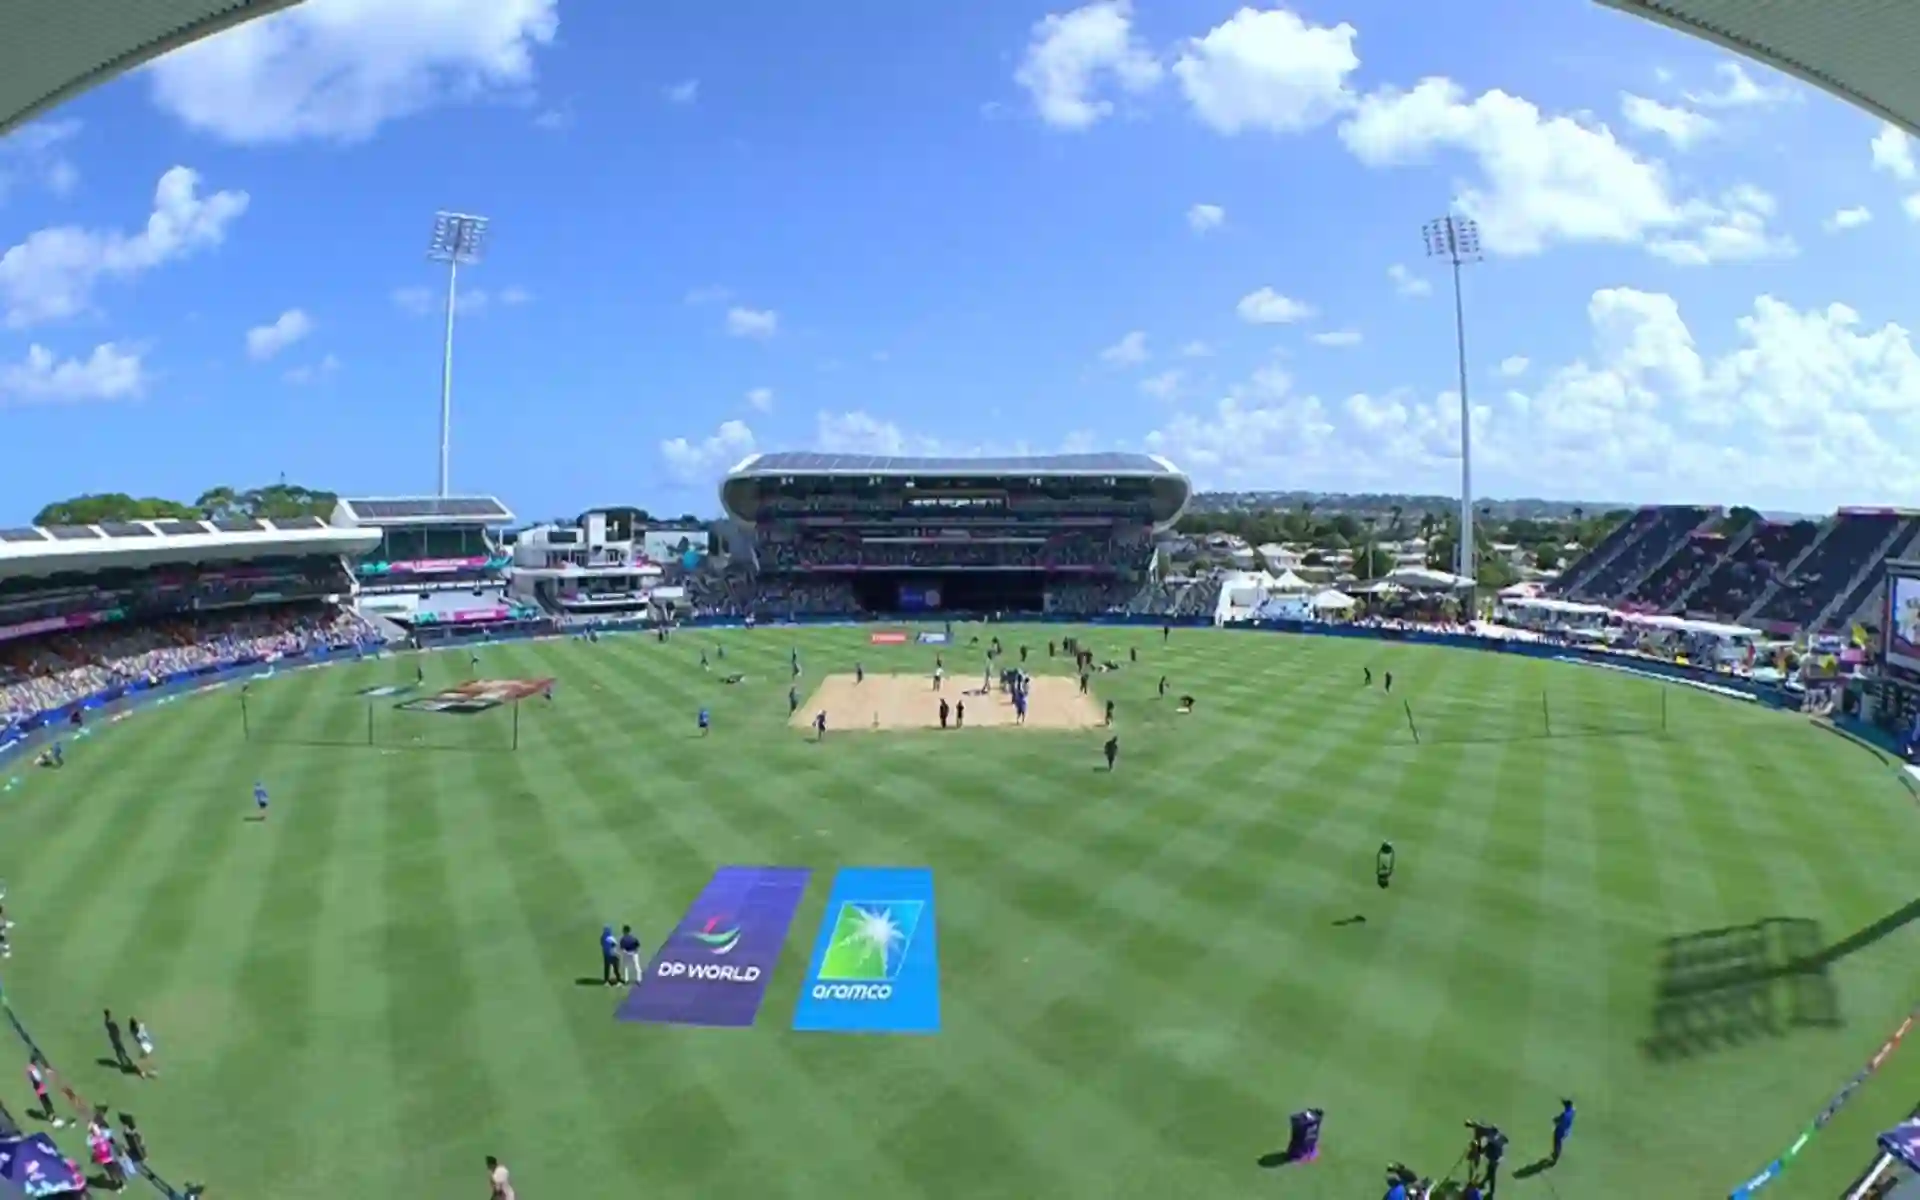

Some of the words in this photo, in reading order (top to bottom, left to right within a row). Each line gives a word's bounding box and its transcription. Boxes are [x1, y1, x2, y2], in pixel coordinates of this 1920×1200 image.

[657, 961, 686, 977] DP
[687, 964, 761, 981] WORLD
[811, 984, 892, 1000] aramco
